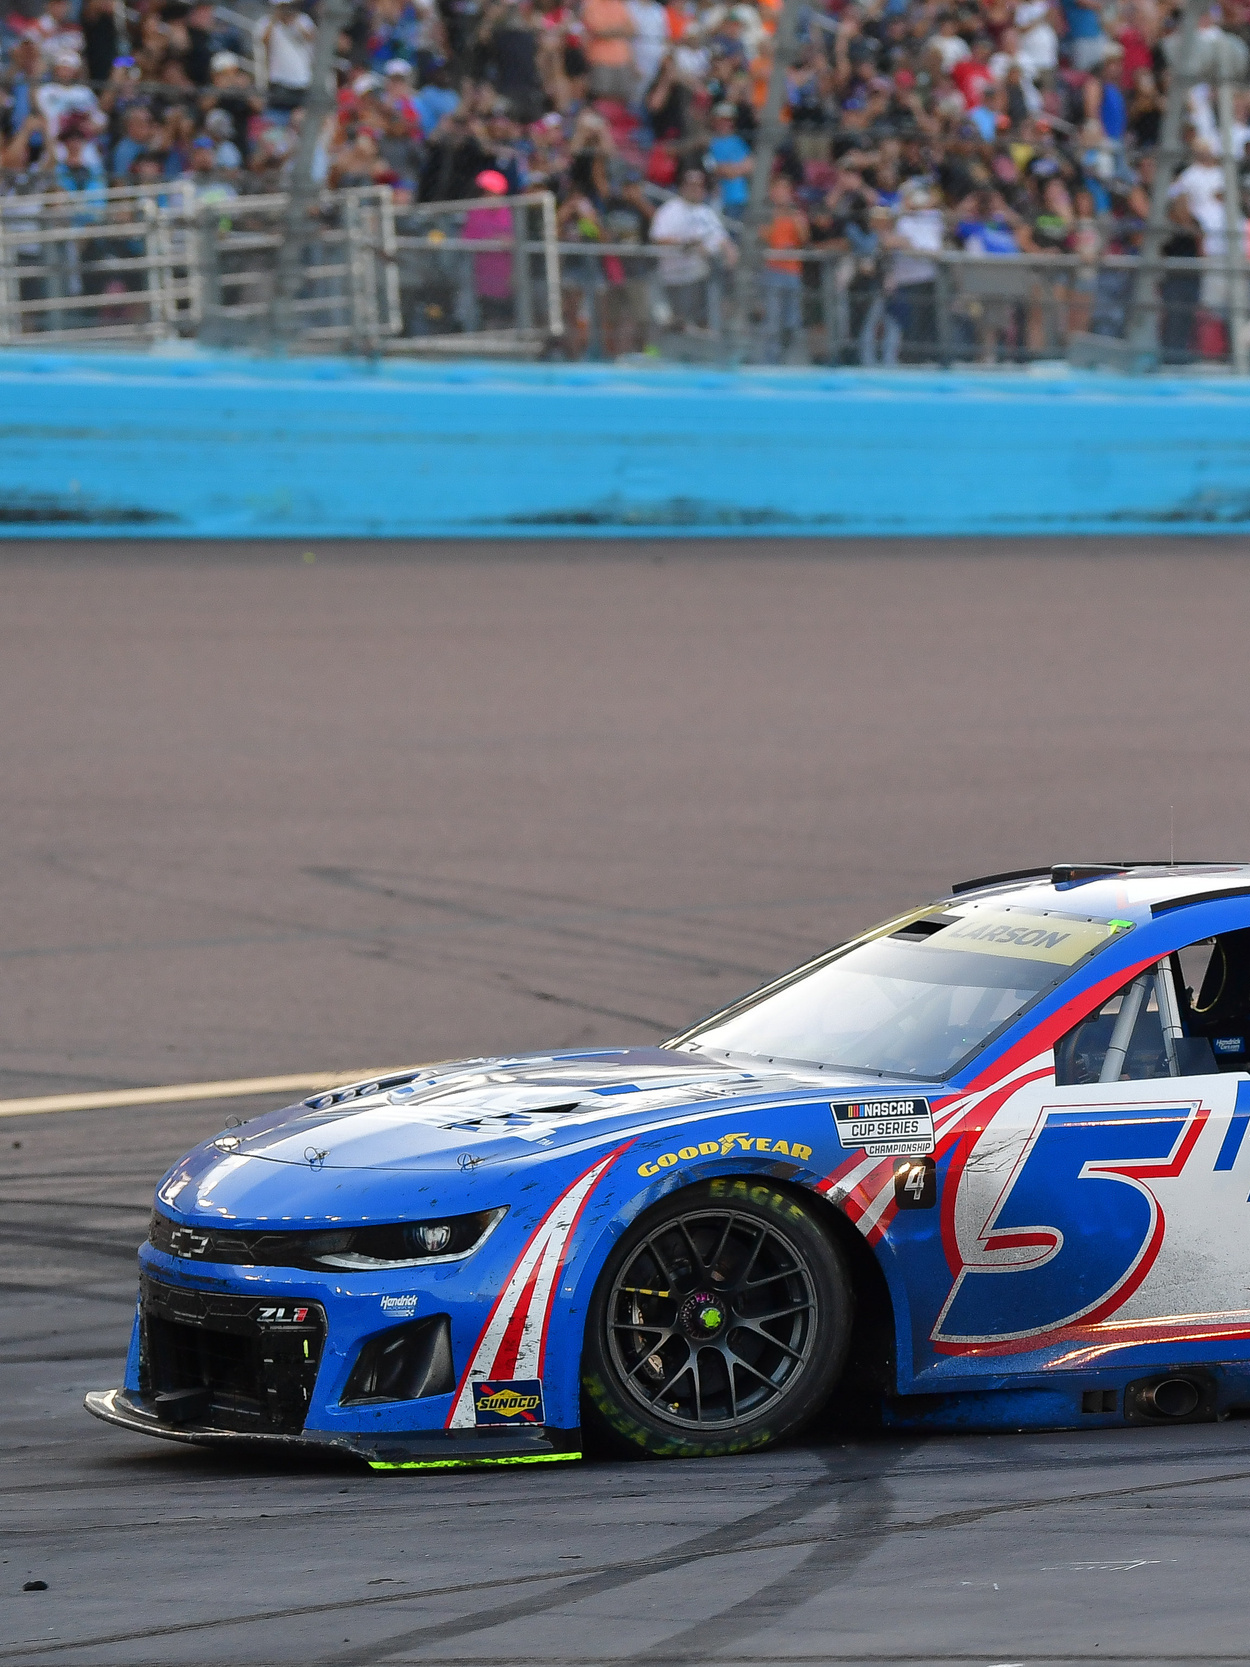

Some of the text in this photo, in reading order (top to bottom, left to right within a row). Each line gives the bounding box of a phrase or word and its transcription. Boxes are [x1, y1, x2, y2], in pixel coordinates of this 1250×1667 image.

[949, 922, 1072, 949] LARSON
[864, 1101, 914, 1117] NASCAR
[851, 1121, 919, 1137] CUP SERIES
[637, 1133, 813, 1178] GOODYEAR
[869, 1142, 931, 1155] CHAMPIONSHIP
[904, 1165, 926, 1200] 4
[930, 1100, 1205, 1345] 5
[380, 1295, 418, 1310] Hendrick
[256, 1308, 309, 1322] ZL1
[479, 1396, 538, 1409] SUNOCO
